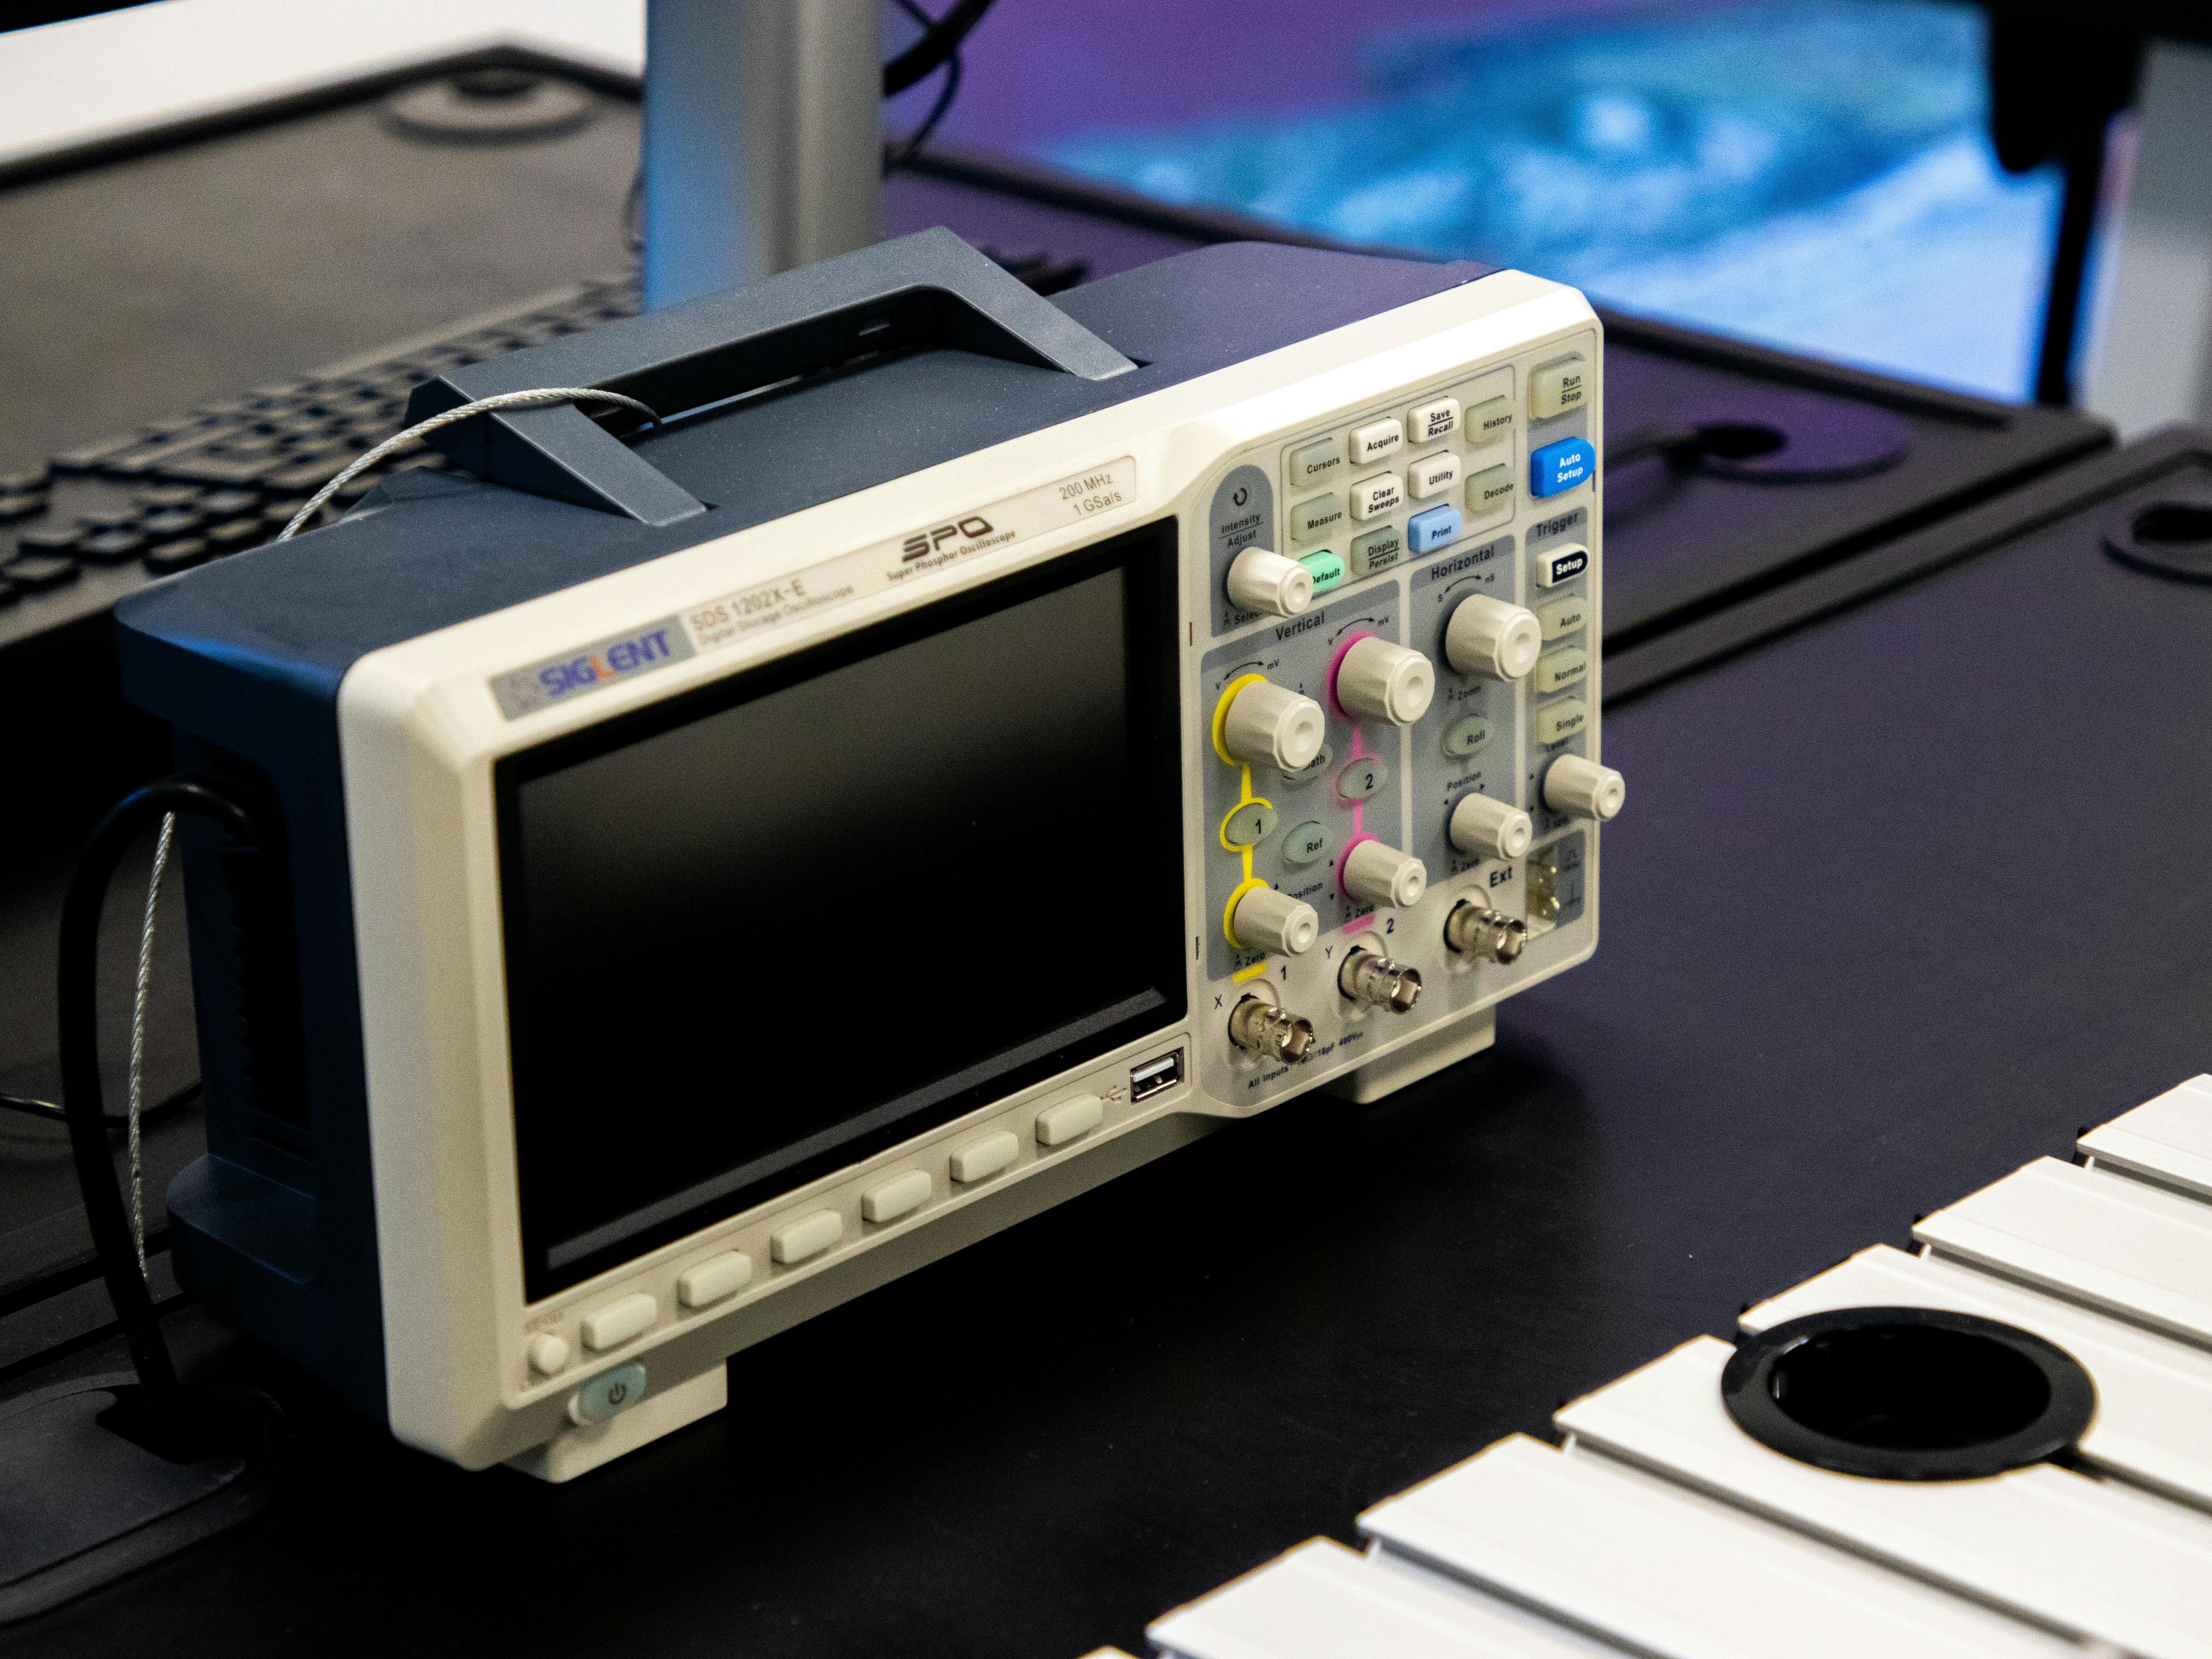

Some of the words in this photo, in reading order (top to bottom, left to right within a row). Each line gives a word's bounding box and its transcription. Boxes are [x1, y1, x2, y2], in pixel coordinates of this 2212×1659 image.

[1563, 375, 1580, 388] Run
[1561, 391, 1582, 404] Stop
[1430, 409, 1450, 422] Save
[1483, 414, 1512, 430] History
[1428, 421, 1453, 436] Recall
[1367, 434, 1399, 451] Acquire
[1307, 457, 1340, 474] Cursors
[1560, 453, 1581, 468] Auto
[1429, 470, 1453, 485] Utility
[1557, 467, 1583, 483] Setup
[1059, 482, 1083, 500] 200
[1084, 473, 1113, 491] MHz
[1373, 487, 1394, 501] Clear
[1484, 483, 1514, 499] Decode
[1073, 504, 1082, 515] 1
[1084, 491, 1122, 511] GSa/s
[1369, 496, 1399, 513] Sweeps
[1222, 514, 1260, 533] Intensity
[1308, 512, 1342, 530] Measure
[1535, 512, 1578, 537] Trigger
[1228, 530, 1256, 547] Adjust
[1432, 525, 1451, 540] Print
[886, 567, 913, 581] Super
[916, 550, 958, 572] Phosphor
[960, 530, 1016, 556] Oscilloscope
[1369, 539, 1399, 556] Display
[1369, 552, 1398, 569] Persist
[1431, 545, 1494, 581] Horizontal
[1556, 558, 1582, 575] Setup
[1313, 568, 1340, 584] Default
[690, 606, 729, 632] SDS
[732, 579, 807, 615] 1202X-E
[1235, 611, 1259, 625] Selec
[1276, 611, 1325, 640] Vertical
[1378, 615, 1389, 626] mV
[1560, 614, 1581, 628] Auto
[538, 630, 671, 697] SIGLENT
[1267, 659, 1279, 670] mV
[1466, 730, 1485, 745] Roll
[1366, 774, 1373, 789] 2
[1446, 771, 1481, 791] Position
[1256, 819, 1261, 834] 1
[1307, 838, 1322, 854] Ref
[1490, 866, 1512, 888] Ext
[1386, 918, 1394, 934] 2
[1245, 952, 1265, 966] Zero
[1325, 946, 1332, 958] Y
[1281, 964, 1286, 980] 1
[1214, 995, 1222, 1010] X
[1248, 1077, 1259, 1089] All
[1263, 1065, 1288, 1081] Inputs
